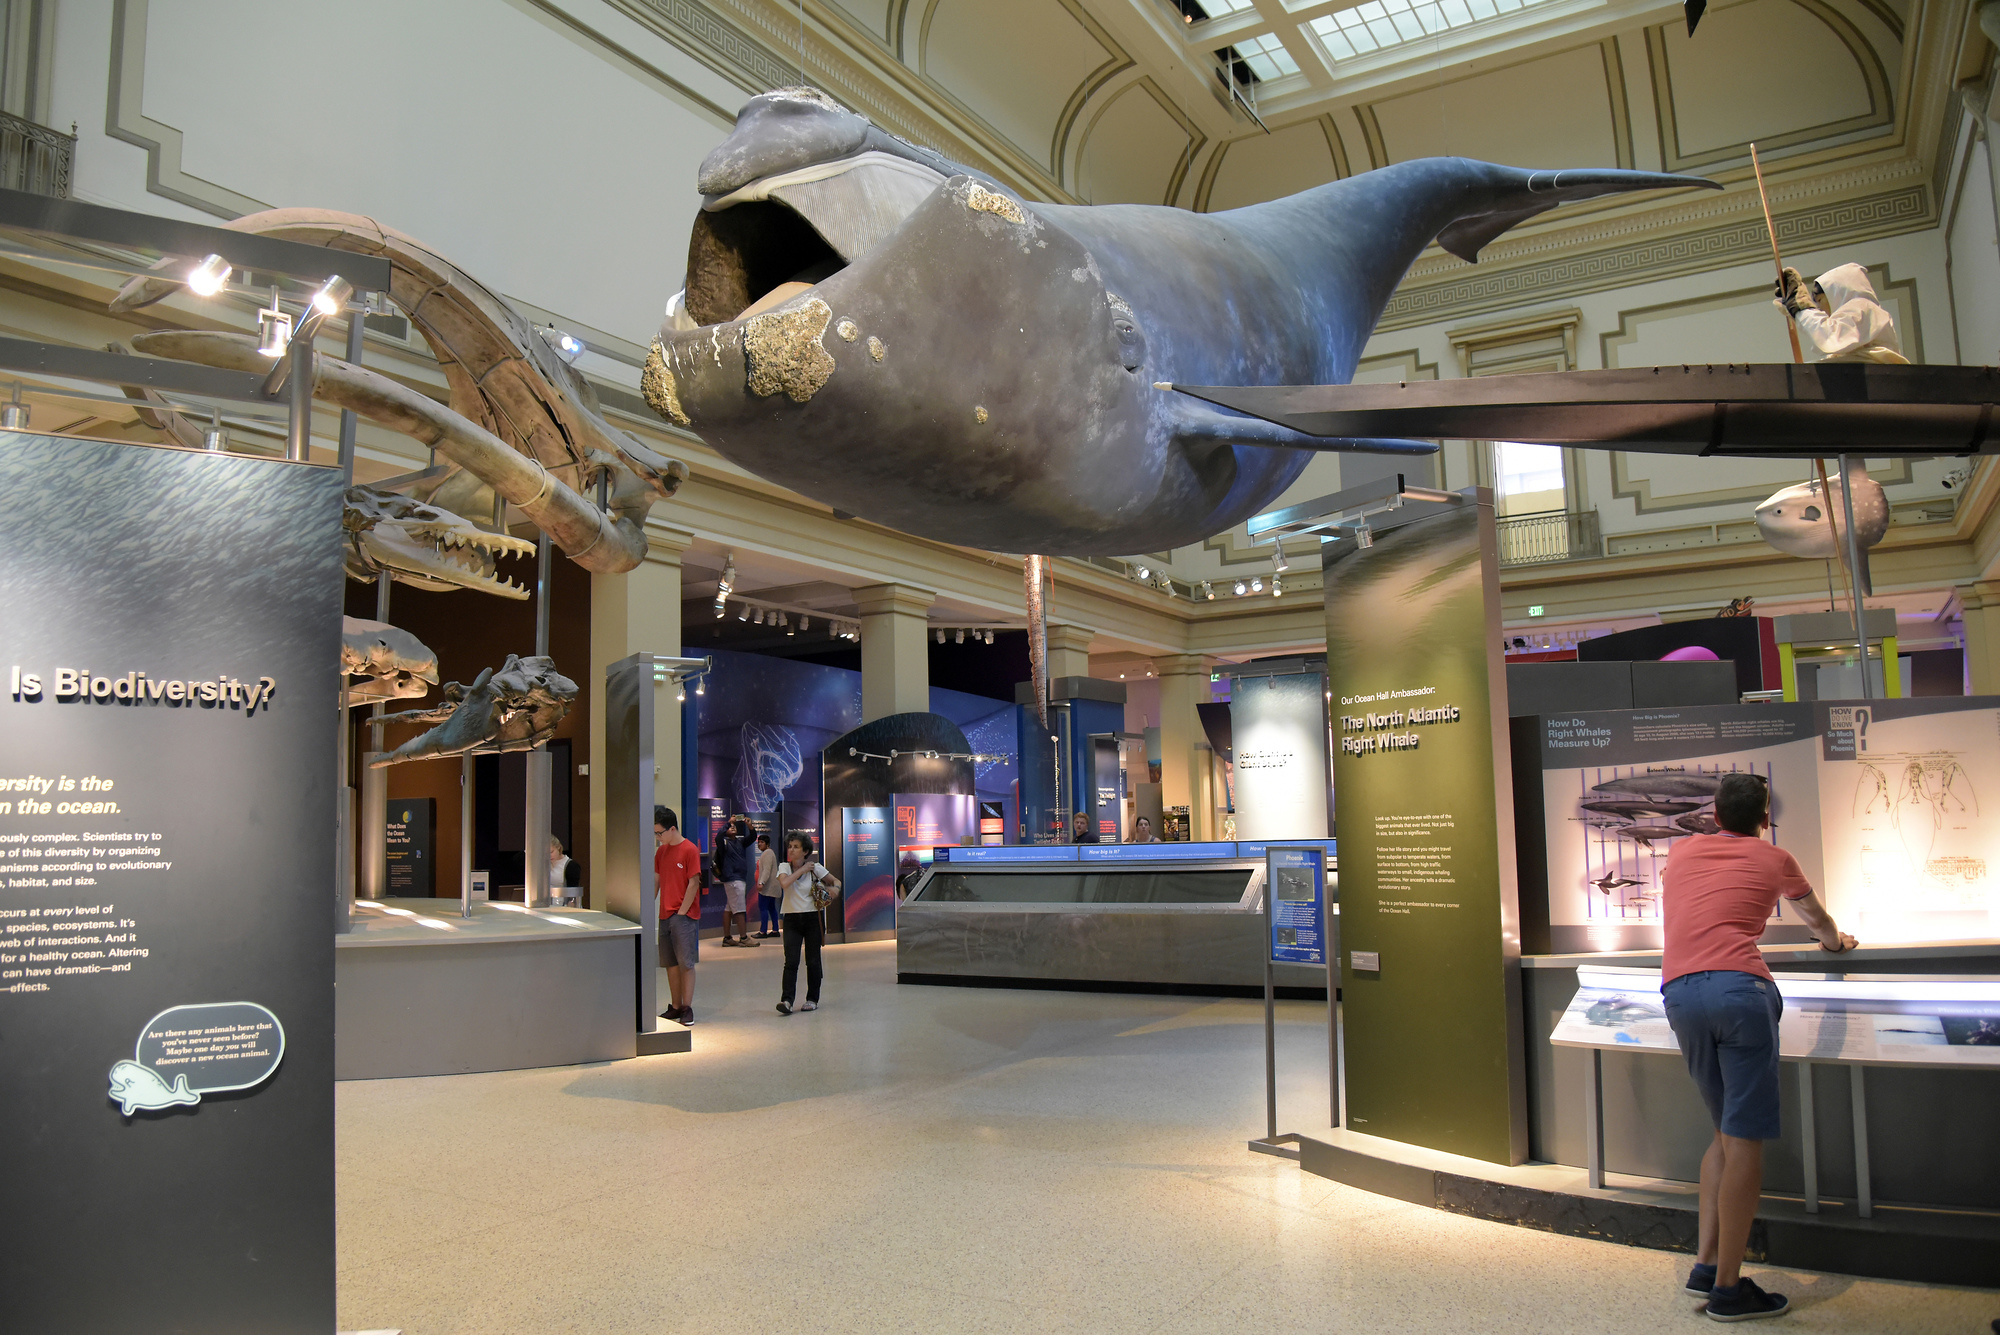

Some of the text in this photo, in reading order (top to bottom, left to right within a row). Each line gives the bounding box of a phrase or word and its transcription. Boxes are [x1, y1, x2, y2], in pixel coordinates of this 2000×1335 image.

[11, 665, 276, 709] Is Biodiversity?
[1341, 686, 1435, 705] Our Ocean Hall Ambassador:
[1340, 704, 1460, 730] The North Atlantic
[1548, 728, 1611, 739] Right Whales
[1342, 731, 1419, 753] Right Whale
[1549, 738, 1610, 748] Measure Up?
[58, 775, 76, 791] is
[80, 776, 114, 791] the
[18, 798, 121, 814] the ocean.
[32, 833, 80, 843] complex.
[83, 832, 132, 842] Scientists
[135, 833, 149, 842] try
[8, 846, 161, 858] of this diversity by organizing
[42, 862, 93, 872] according
[109, 861, 172, 870] evolutionary
[9, 877, 97, 888] habitat, and size.
[44, 908, 74, 917] every
[76, 906, 99, 915] level
[102, 904, 114, 914] of
[6, 923, 50, 934] species,
[53, 921, 117, 931] ecosystems.
[0, 938, 21, 948] web
[24, 937, 35, 946] of
[38, 936, 102, 946] interactions.
[105, 933, 126, 943] And
[1, 954, 17, 963] for
[30, 952, 69, 961] healthy
[71, 950, 105, 959] ocean.
[108, 948, 149, 958] Altering
[3, 969, 22, 978] can
[26, 967, 51, 977] have
[204, 1025, 236, 1034] animals
[162, 1038, 187, 1048] you've
[232, 1032, 259, 1040] before?
[156, 1057, 190, 1065] discover
[241, 1049, 270, 1058] animal.
[166, 1047, 192, 1056] Maybe
